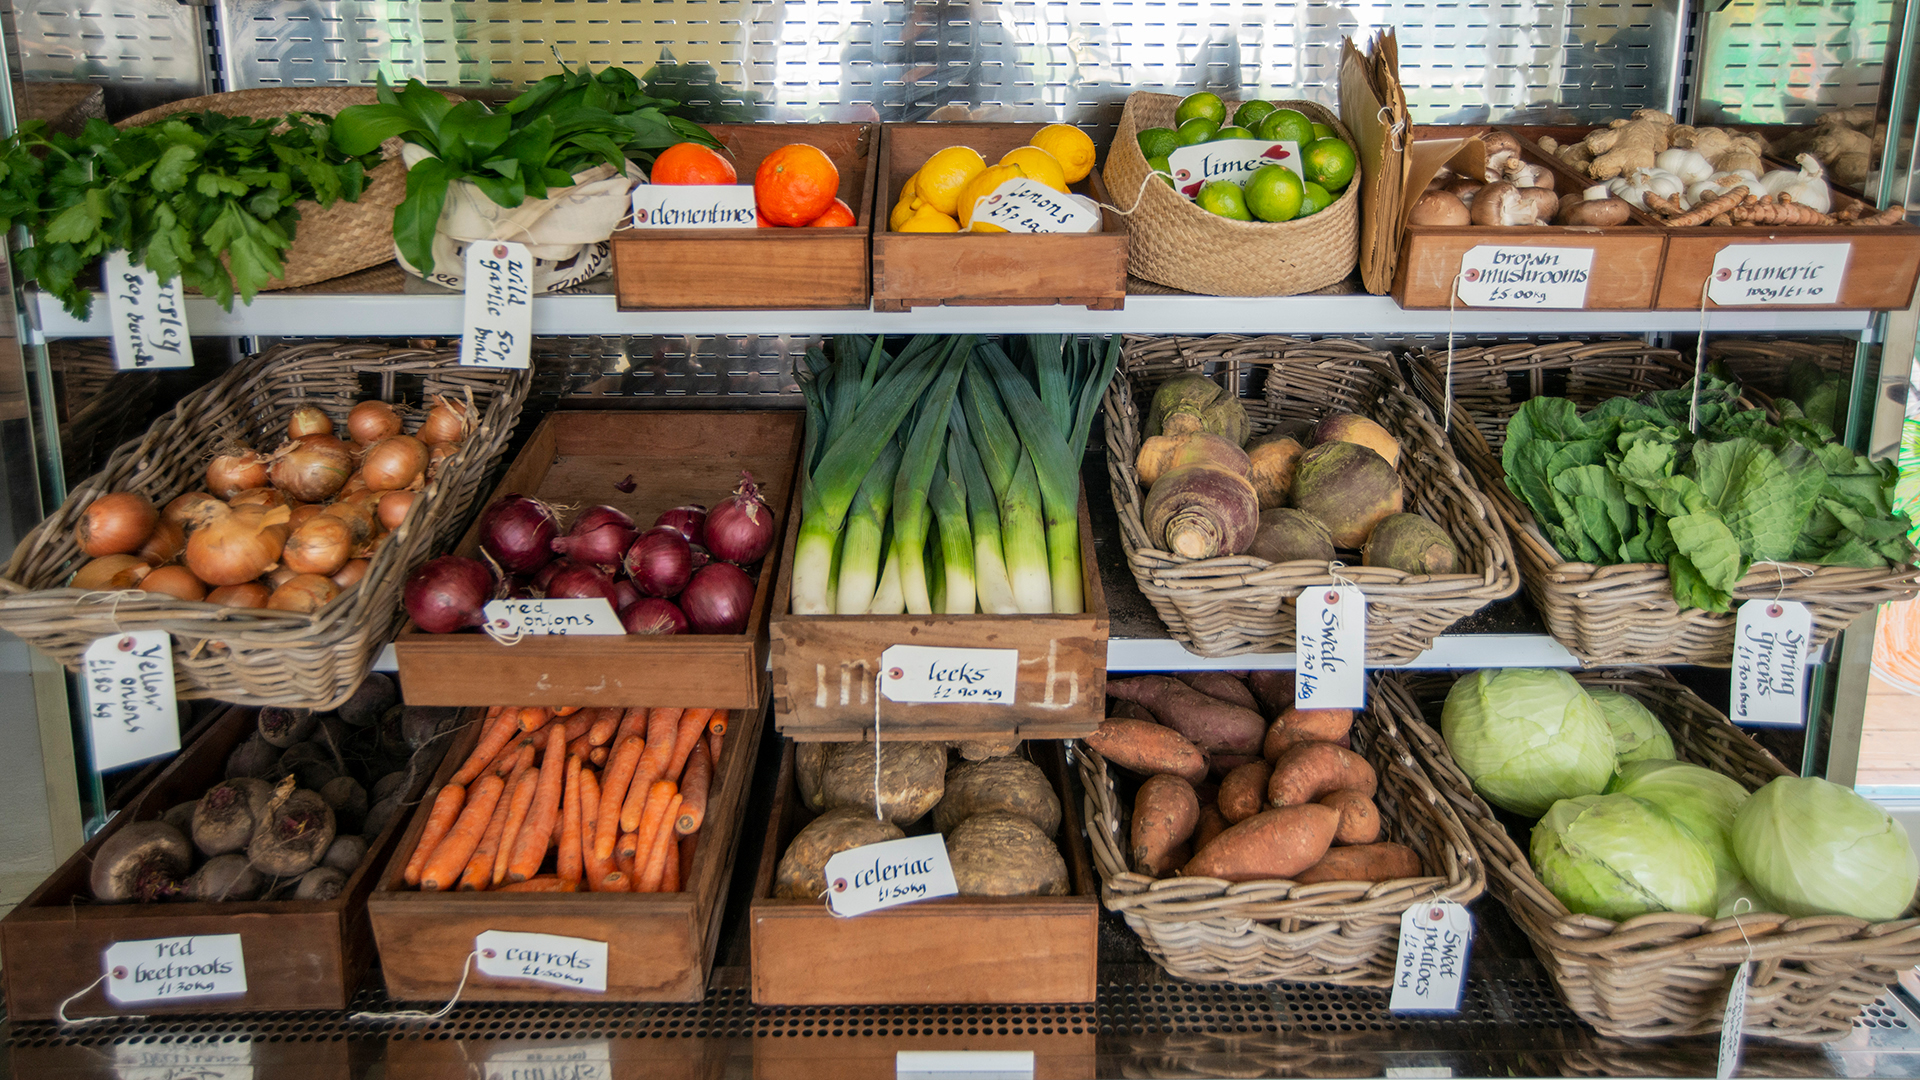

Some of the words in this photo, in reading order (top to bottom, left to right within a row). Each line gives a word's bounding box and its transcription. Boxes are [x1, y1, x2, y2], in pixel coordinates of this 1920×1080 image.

[1479, 261, 1588, 284] mushrooms
[1492, 249, 1560, 266] brown
[1733, 258, 1824, 282] tumeric
[120, 273, 144, 305] 80p
[479, 259, 504, 316] garlic
[147, 284, 183, 355] rsley
[488, 330, 514, 360] 50p
[505, 602, 549, 615] red
[524, 614, 594, 626] onions
[1321, 608, 1348, 673] Swede
[928, 660, 990, 684] leeks
[1745, 624, 1774, 701] greens
[1774, 629, 1804, 697] Spring
[120, 677, 144, 733] onions
[855, 856, 934, 888] celeriac
[155, 936, 196, 958] red
[506, 948, 594, 969] carrots
[1412, 918, 1439, 999] potatoes
[1440, 930, 1461, 979] Sweet
[134, 956, 234, 983] beetroots
